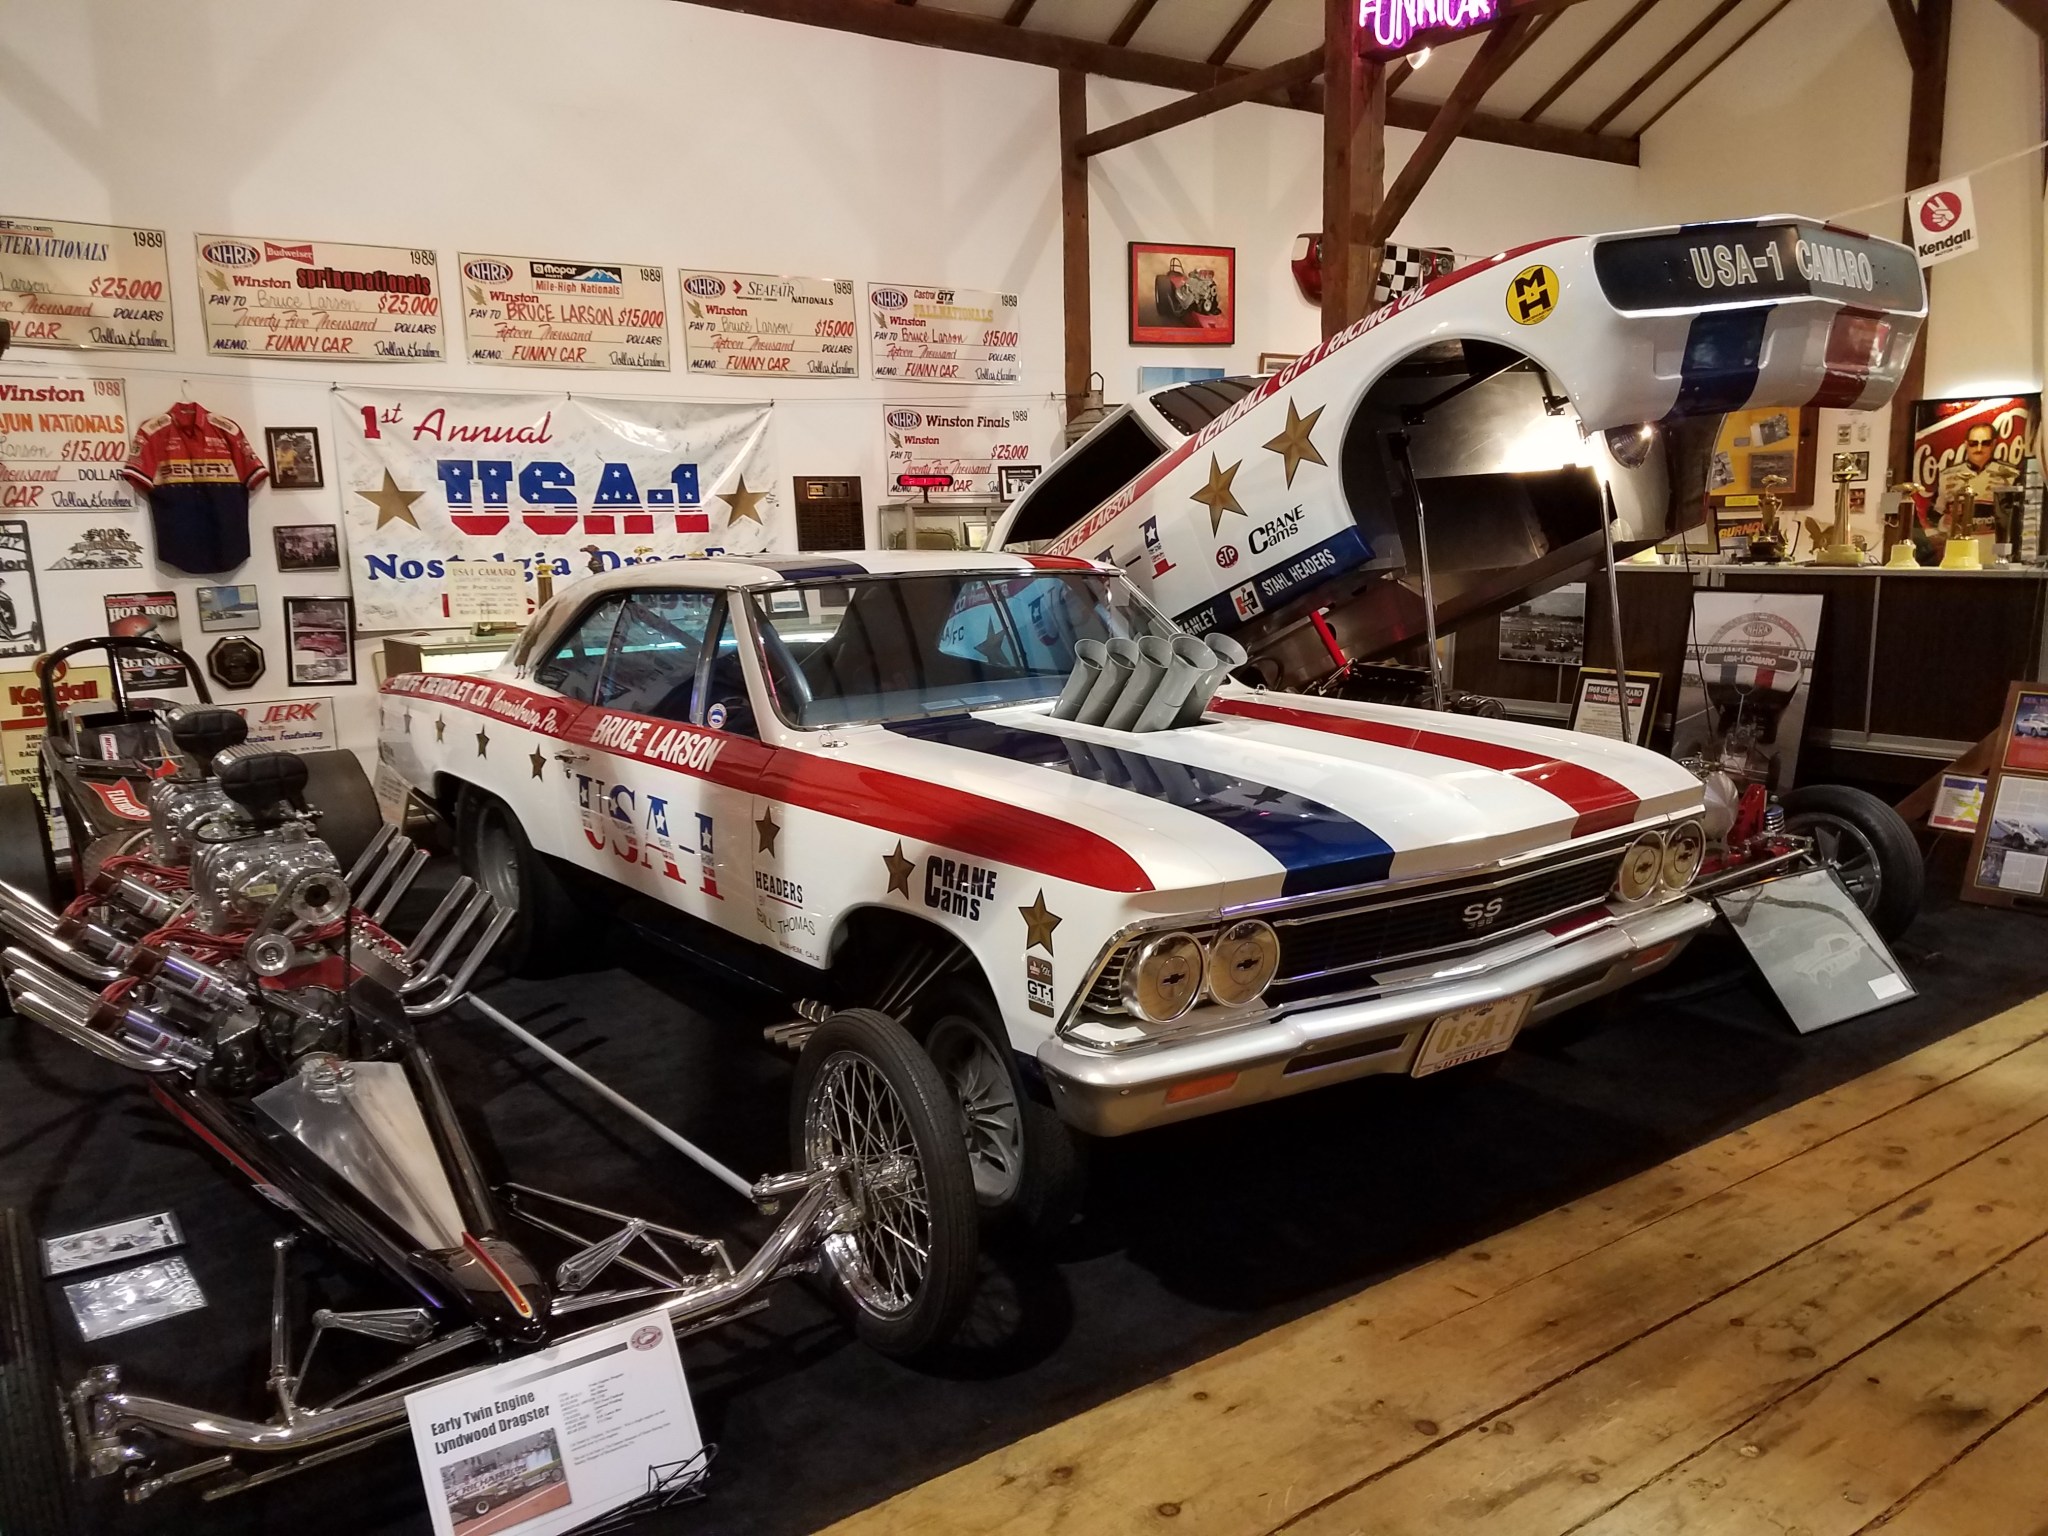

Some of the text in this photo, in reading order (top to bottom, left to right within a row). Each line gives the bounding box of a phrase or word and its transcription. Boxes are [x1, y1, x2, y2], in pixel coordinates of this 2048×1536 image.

[0, 235, 109, 261] TERNATIONALS
[133, 232, 163, 247] 1989
[1918, 229, 1971, 257] Kendall
[211, 247, 435, 265] NHRA Budweiser 1989
[471, 264, 661, 282] NHRA Mopar 1989
[1690, 239, 1873, 292] USA-1 CAMARO
[232, 267, 431, 295] Winston springnationals
[535, 280, 620, 295] Mile-High Nationals
[690, 280, 721, 294] NHRA
[833, 282, 852, 295] 1989
[208, 295, 231, 306] PAY
[233, 296, 246, 306] TO
[489, 291, 539, 303] Winston
[791, 296, 834, 306] NATIONALS
[877, 290, 1017, 307] NHRA Castrol GTX 1989
[113, 308, 164, 321] DOLLARS
[469, 309, 487, 319] PAY
[489, 309, 501, 319] TO
[506, 303, 555, 321] BRUCE
[560, 304, 614, 325] LARSON
[705, 305, 748, 316] Winston
[25, 322, 62, 339] CAR
[394, 323, 437, 334] DOLLARS
[688, 321, 704, 331] PAY
[705, 322, 716, 331] TO
[890, 316, 927, 327] Winston
[266, 335, 319, 350] FUNNY
[322, 338, 353, 353] CAR
[626, 334, 662, 345] DOLLARS
[873, 331, 888, 340] PAY
[888, 332, 898, 341] TO
[902, 327, 929, 343] Bruce
[512, 345, 558, 360] FUNNY
[559, 347, 587, 362] CAR
[822, 344, 853, 354] DOLLARS
[988, 353, 1016, 362] DOLLARS
[726, 355, 766, 370] FUNNY
[767, 357, 791, 371] CAR
[905, 363, 939, 377] FUNNY
[940, 364, 959, 378] CAR
[1193, 284, 1430, 452] KENDALL GT-1 RACING OIL
[93, 381, 121, 396] 1988
[0, 413, 125, 434] JUN NATIONALS
[360, 403, 553, 445] 1st Annual
[892, 410, 1028, 428] NHRA Winston Finals 1989
[904, 436, 939, 445] Winston
[890, 451, 902, 459] PAY
[904, 451, 912, 459] TO
[78, 469, 126, 481] DOLLAR
[161, 464, 231, 475] SENTRY
[953, 479, 973, 492] CAR
[4, 486, 43, 507] CAR
[437, 459, 710, 536] USA-1
[1088, 484, 1136, 536] LARSON
[1248, 504, 1305, 554] CRANE
[1218, 546, 1236, 567] STP
[478, 568, 516, 576] CAMARO
[1261, 548, 1336, 596] STAHL HEADERS
[108, 605, 177, 623] HOT ROD
[1179, 607, 1218, 636] ANLEY
[1746, 625, 1768, 634] NHRA
[1745, 656, 1776, 666] CAMARO
[9, 680, 98, 705] Kedall
[259, 702, 320, 723] JERK
[590, 714, 727, 773] BRUCE LARSON
[576, 773, 725, 901] USA-1
[755, 870, 803, 904] HEADERS
[925, 855, 997, 903] CRANE
[1462, 897, 1503, 922] SS
[777, 916, 816, 936] THOMAS
[1027, 980, 1053, 1001] GT-1
[1028, 994, 1045, 1004] RACING
[431, 1392, 535, 1437] Early Twin Engine
[435, 1405, 549, 1455] Lyndwood Dragster
